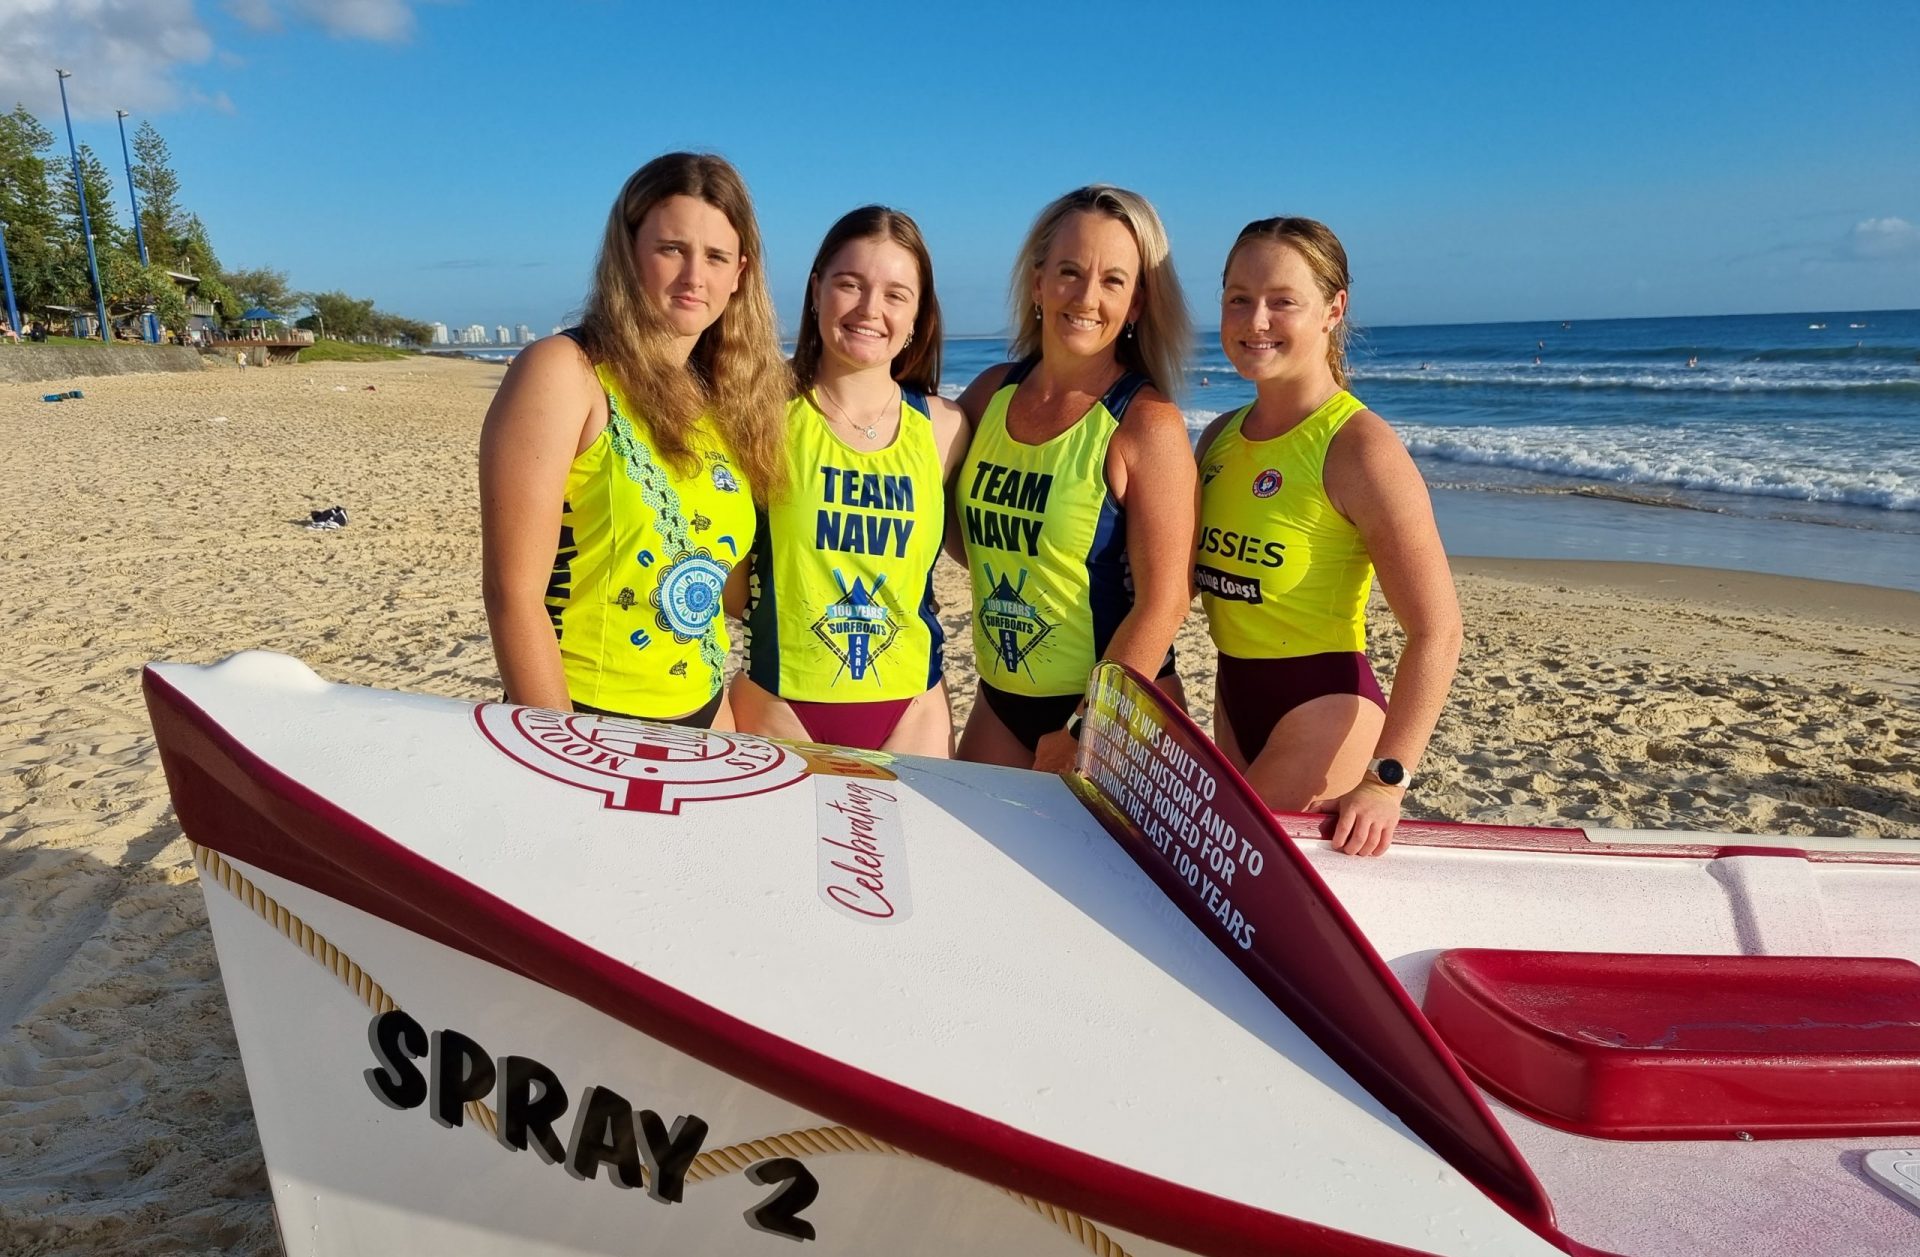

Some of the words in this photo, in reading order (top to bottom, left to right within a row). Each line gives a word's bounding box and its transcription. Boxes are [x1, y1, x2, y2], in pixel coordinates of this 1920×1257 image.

[821, 466, 915, 512] TEAM
[970, 460, 1054, 514] TEAM
[816, 509, 915, 558] NAVY
[966, 505, 1044, 557] NAVY
[831, 605, 852, 617] 100
[855, 606, 884, 619] YEARS
[986, 600, 1001, 611] 100
[1002, 602, 1031, 618] YEARS
[1220, 576, 1257, 598] Coast
[828, 622, 887, 636] SURFBOATS
[985, 615, 1034, 634] SURFBOATS
[1111, 690, 1135, 722] SPRAY
[1132, 708, 1140, 728] 2
[1140, 713, 1162, 749] WAS
[1161, 734, 1198, 786] BUILT
[1198, 770, 1216, 801] TO
[1109, 719, 1128, 748] SURF
[1126, 735, 1151, 770] BOAT
[1149, 756, 1202, 818] HISTORY
[1199, 811, 1236, 851] AND
[1238, 838, 1264, 877] TO
[1110, 746, 1129, 779] WHO
[1128, 764, 1153, 801] EVER
[1152, 789, 1199, 849] ROWED
[1200, 840, 1236, 887] FOR
[822, 781, 898, 918] Celebrating
[1099, 764, 1126, 805] DURING
[1125, 790, 1143, 825] THE
[1143, 816, 1173, 855] LAST
[1172, 845, 1199, 887] 100
[1200, 874, 1255, 950] YEARS
[363, 1010, 709, 1205] SPRAY
[743, 1157, 819, 1243] 2
